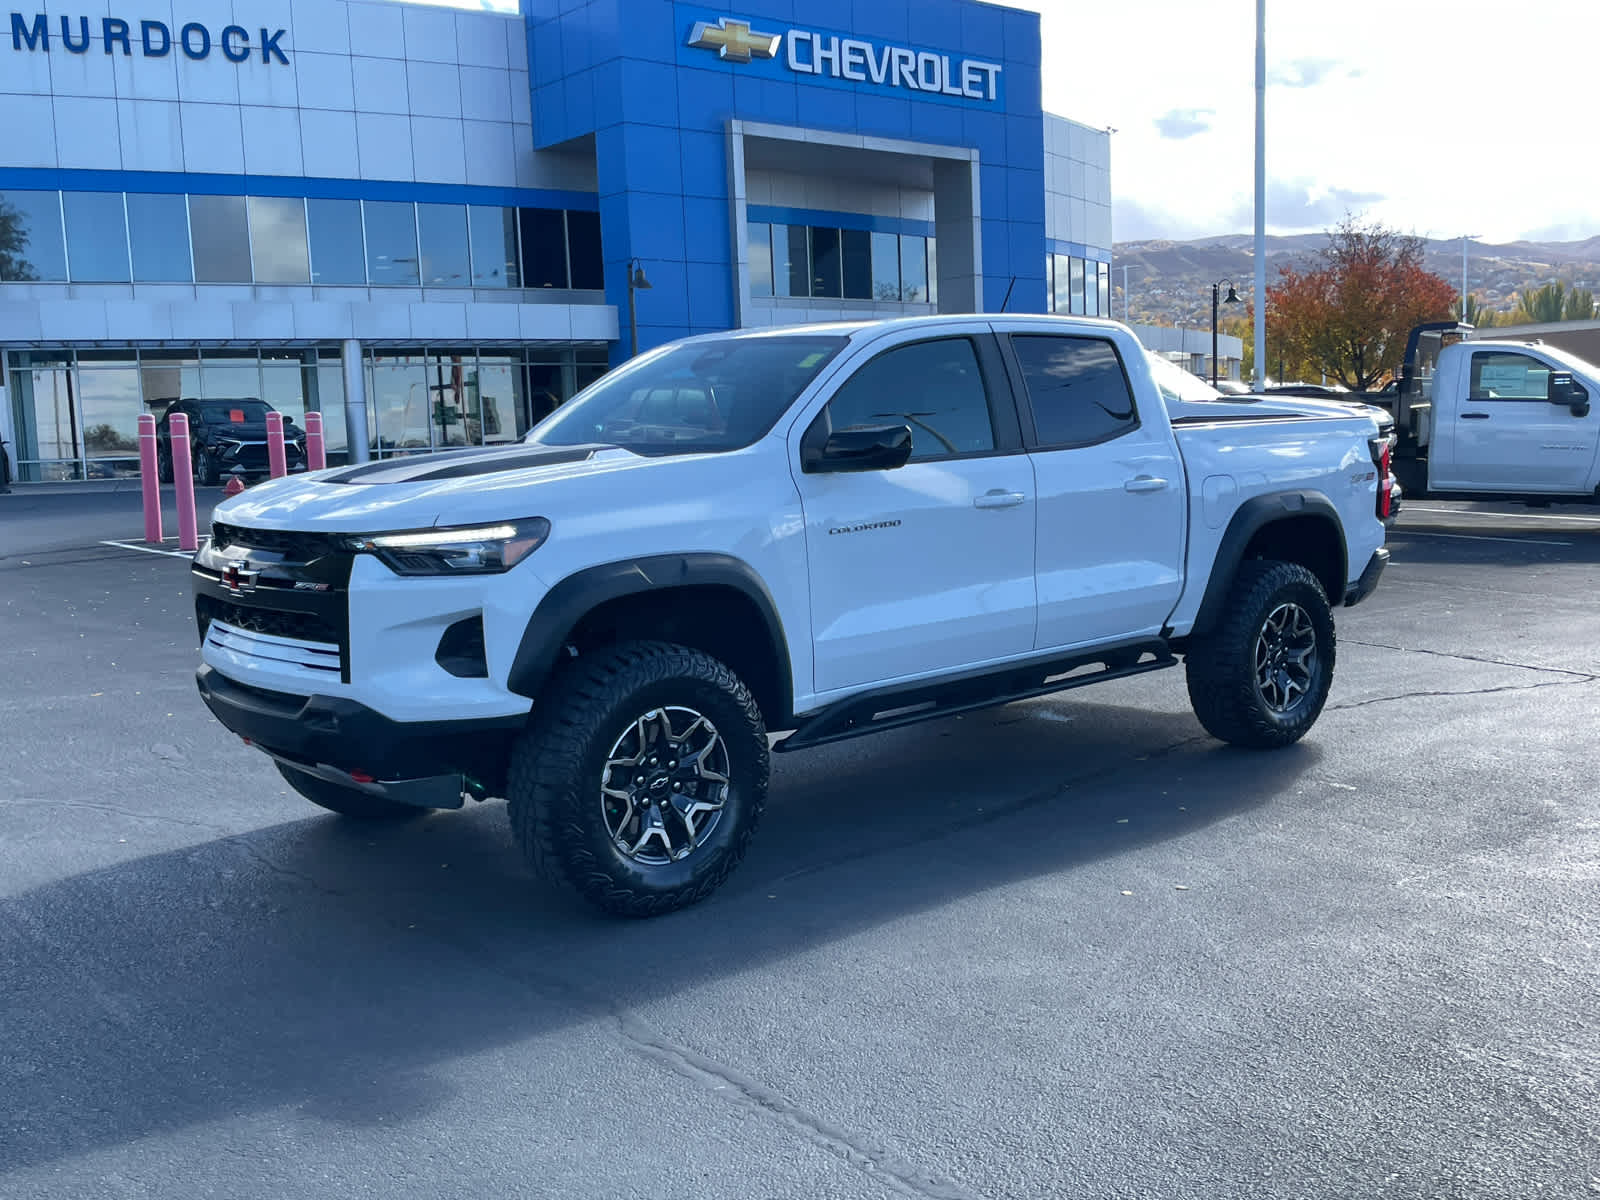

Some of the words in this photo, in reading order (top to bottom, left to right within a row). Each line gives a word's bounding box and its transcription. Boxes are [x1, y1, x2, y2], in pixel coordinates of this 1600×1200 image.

[10, 12, 290, 65] MURDOCK
[787, 29, 1002, 100] CHEVROLET
[828, 519, 902, 535] COLORADO
